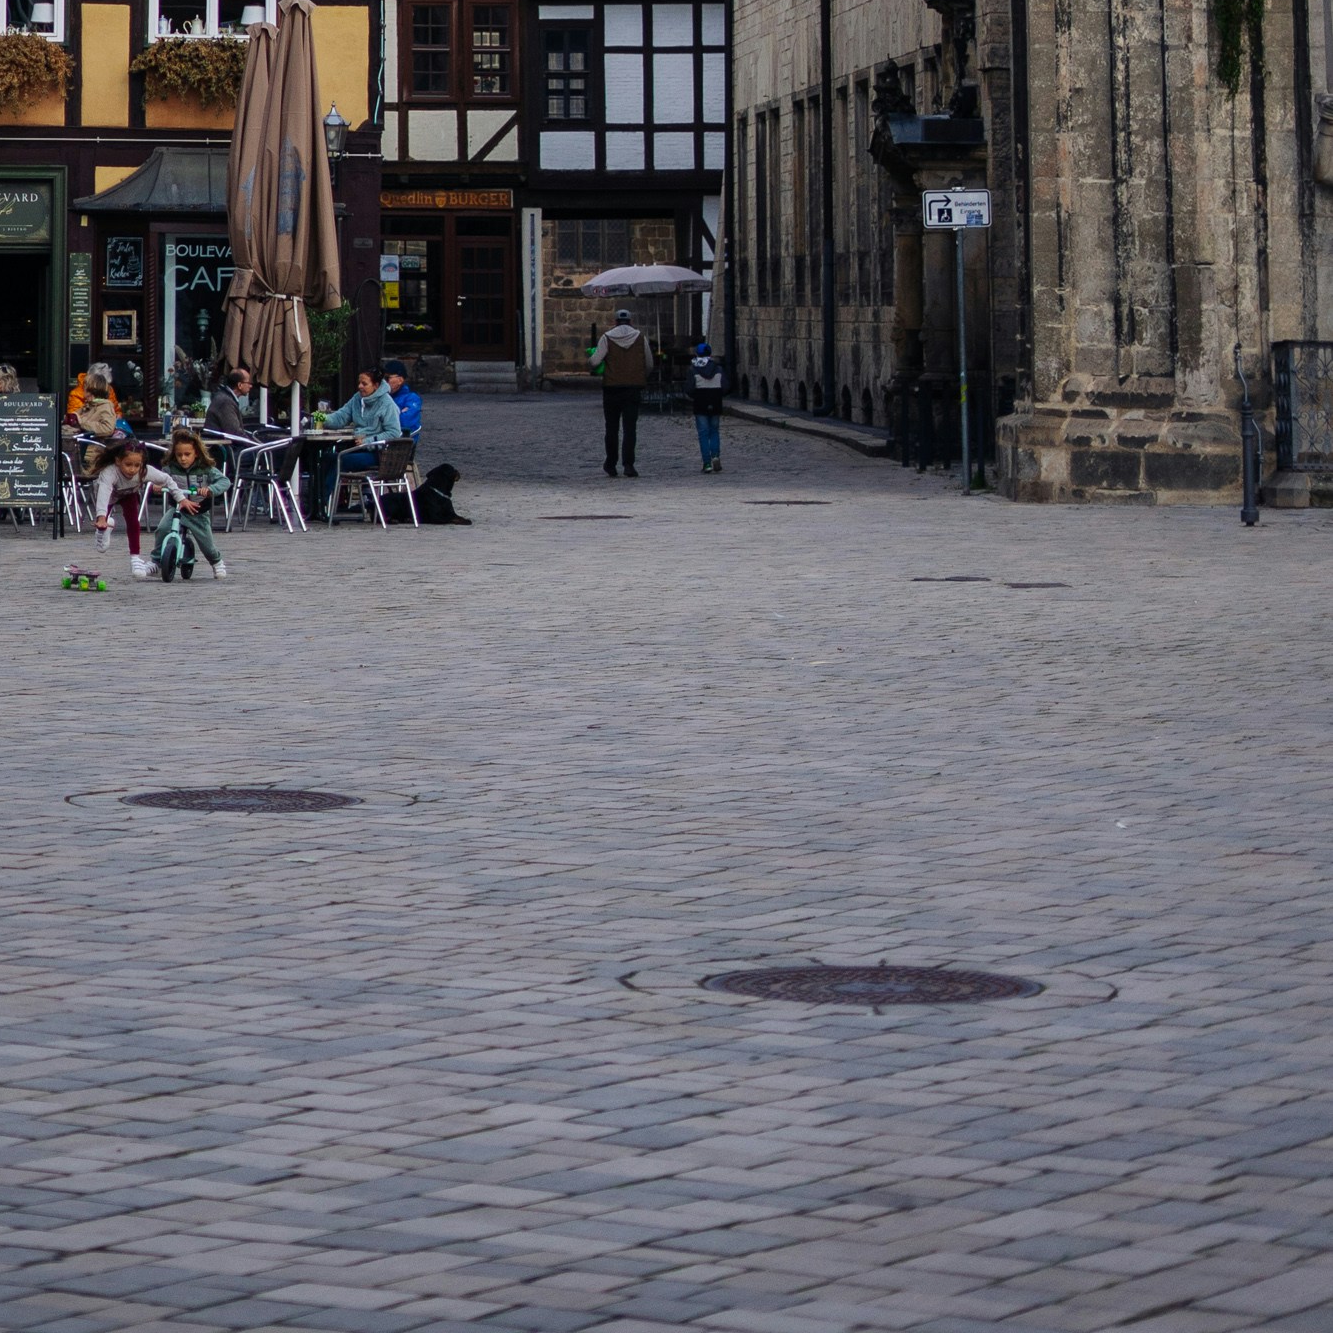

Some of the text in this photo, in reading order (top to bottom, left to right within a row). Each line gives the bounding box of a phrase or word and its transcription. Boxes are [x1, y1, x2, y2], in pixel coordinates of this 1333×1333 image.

[379, 190, 509, 208] Quedlin BURGER
[166, 244, 233, 258] BOULEVA
[164, 265, 236, 292] CAF
